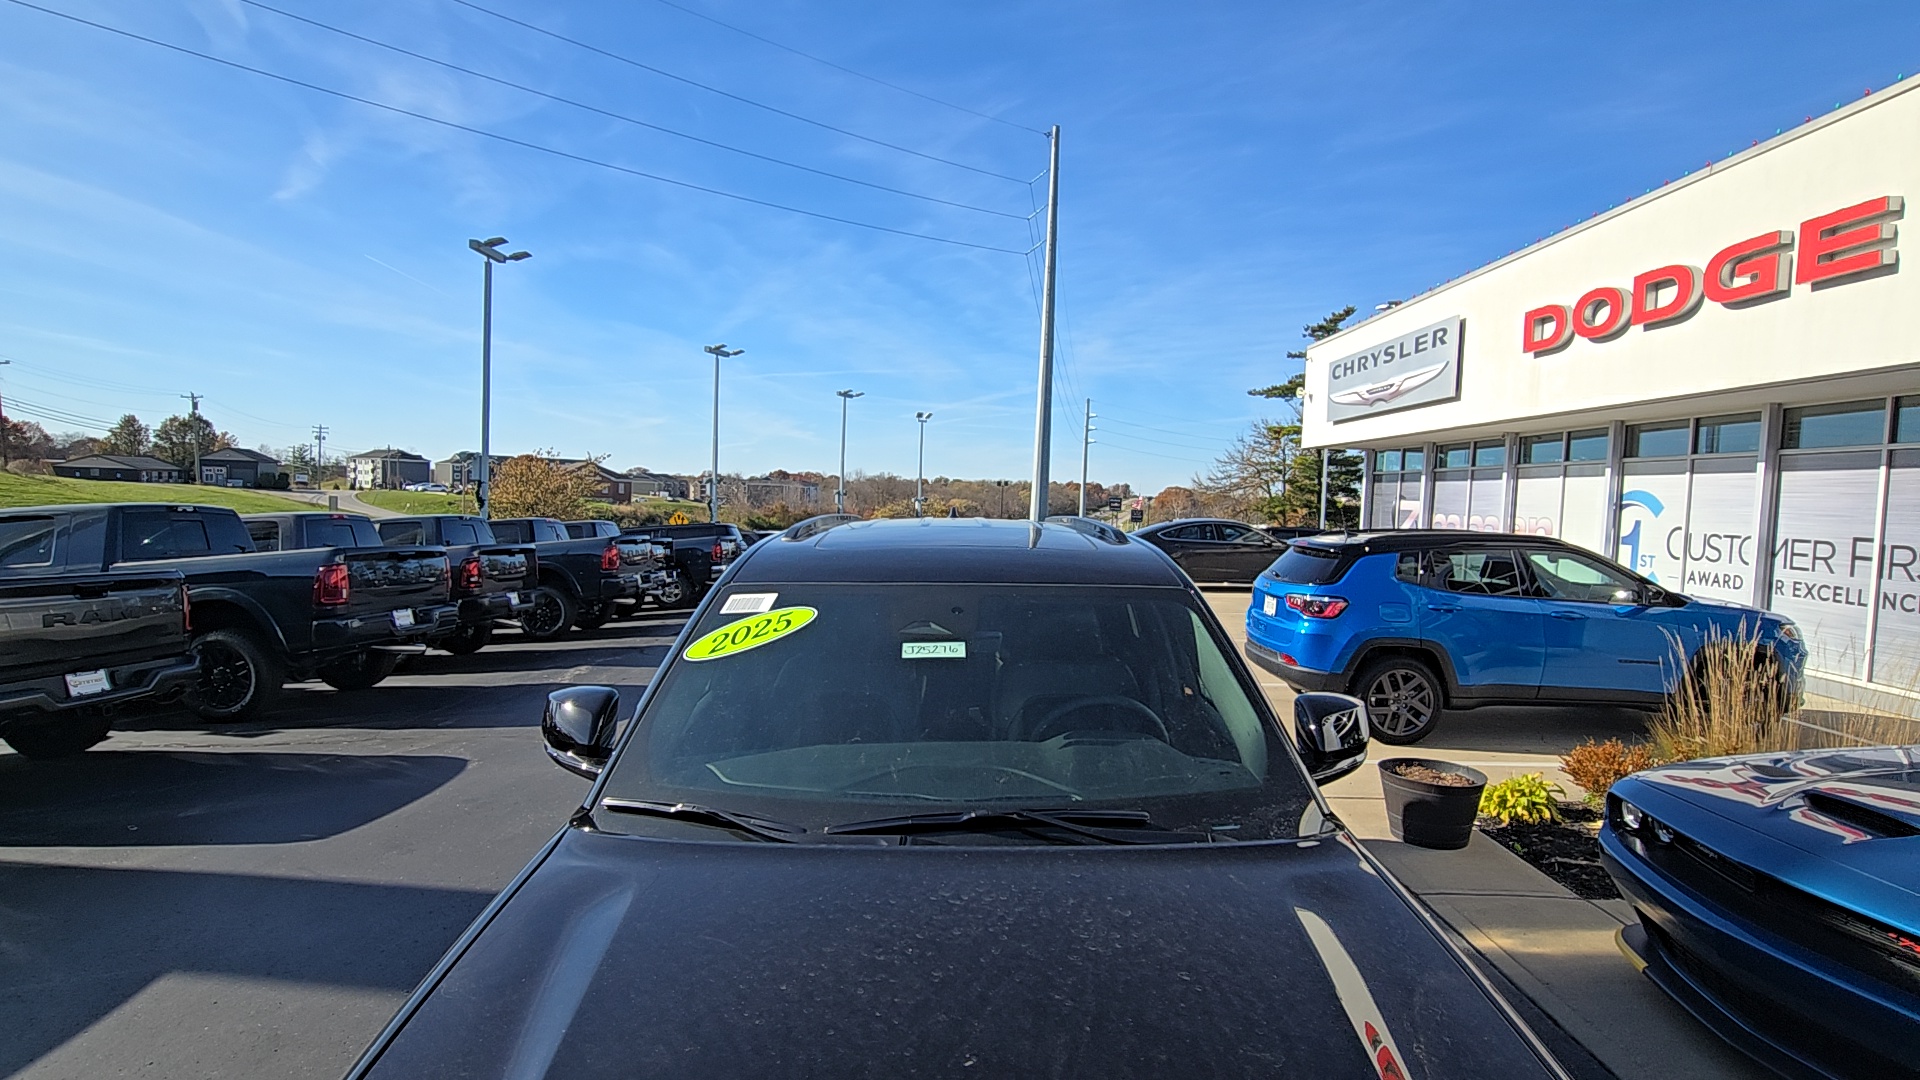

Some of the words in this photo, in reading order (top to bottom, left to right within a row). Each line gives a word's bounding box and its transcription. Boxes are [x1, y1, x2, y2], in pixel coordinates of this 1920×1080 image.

[1522, 195, 1904, 357] DODGE
[1332, 327, 1449, 380] CHRYSLER
[1849, 536, 1920, 582] FIR
[1686, 570, 1744, 590] AWARD
[1792, 580, 1920, 614] EXCELLNC
[708, 611, 794, 655] 2025
